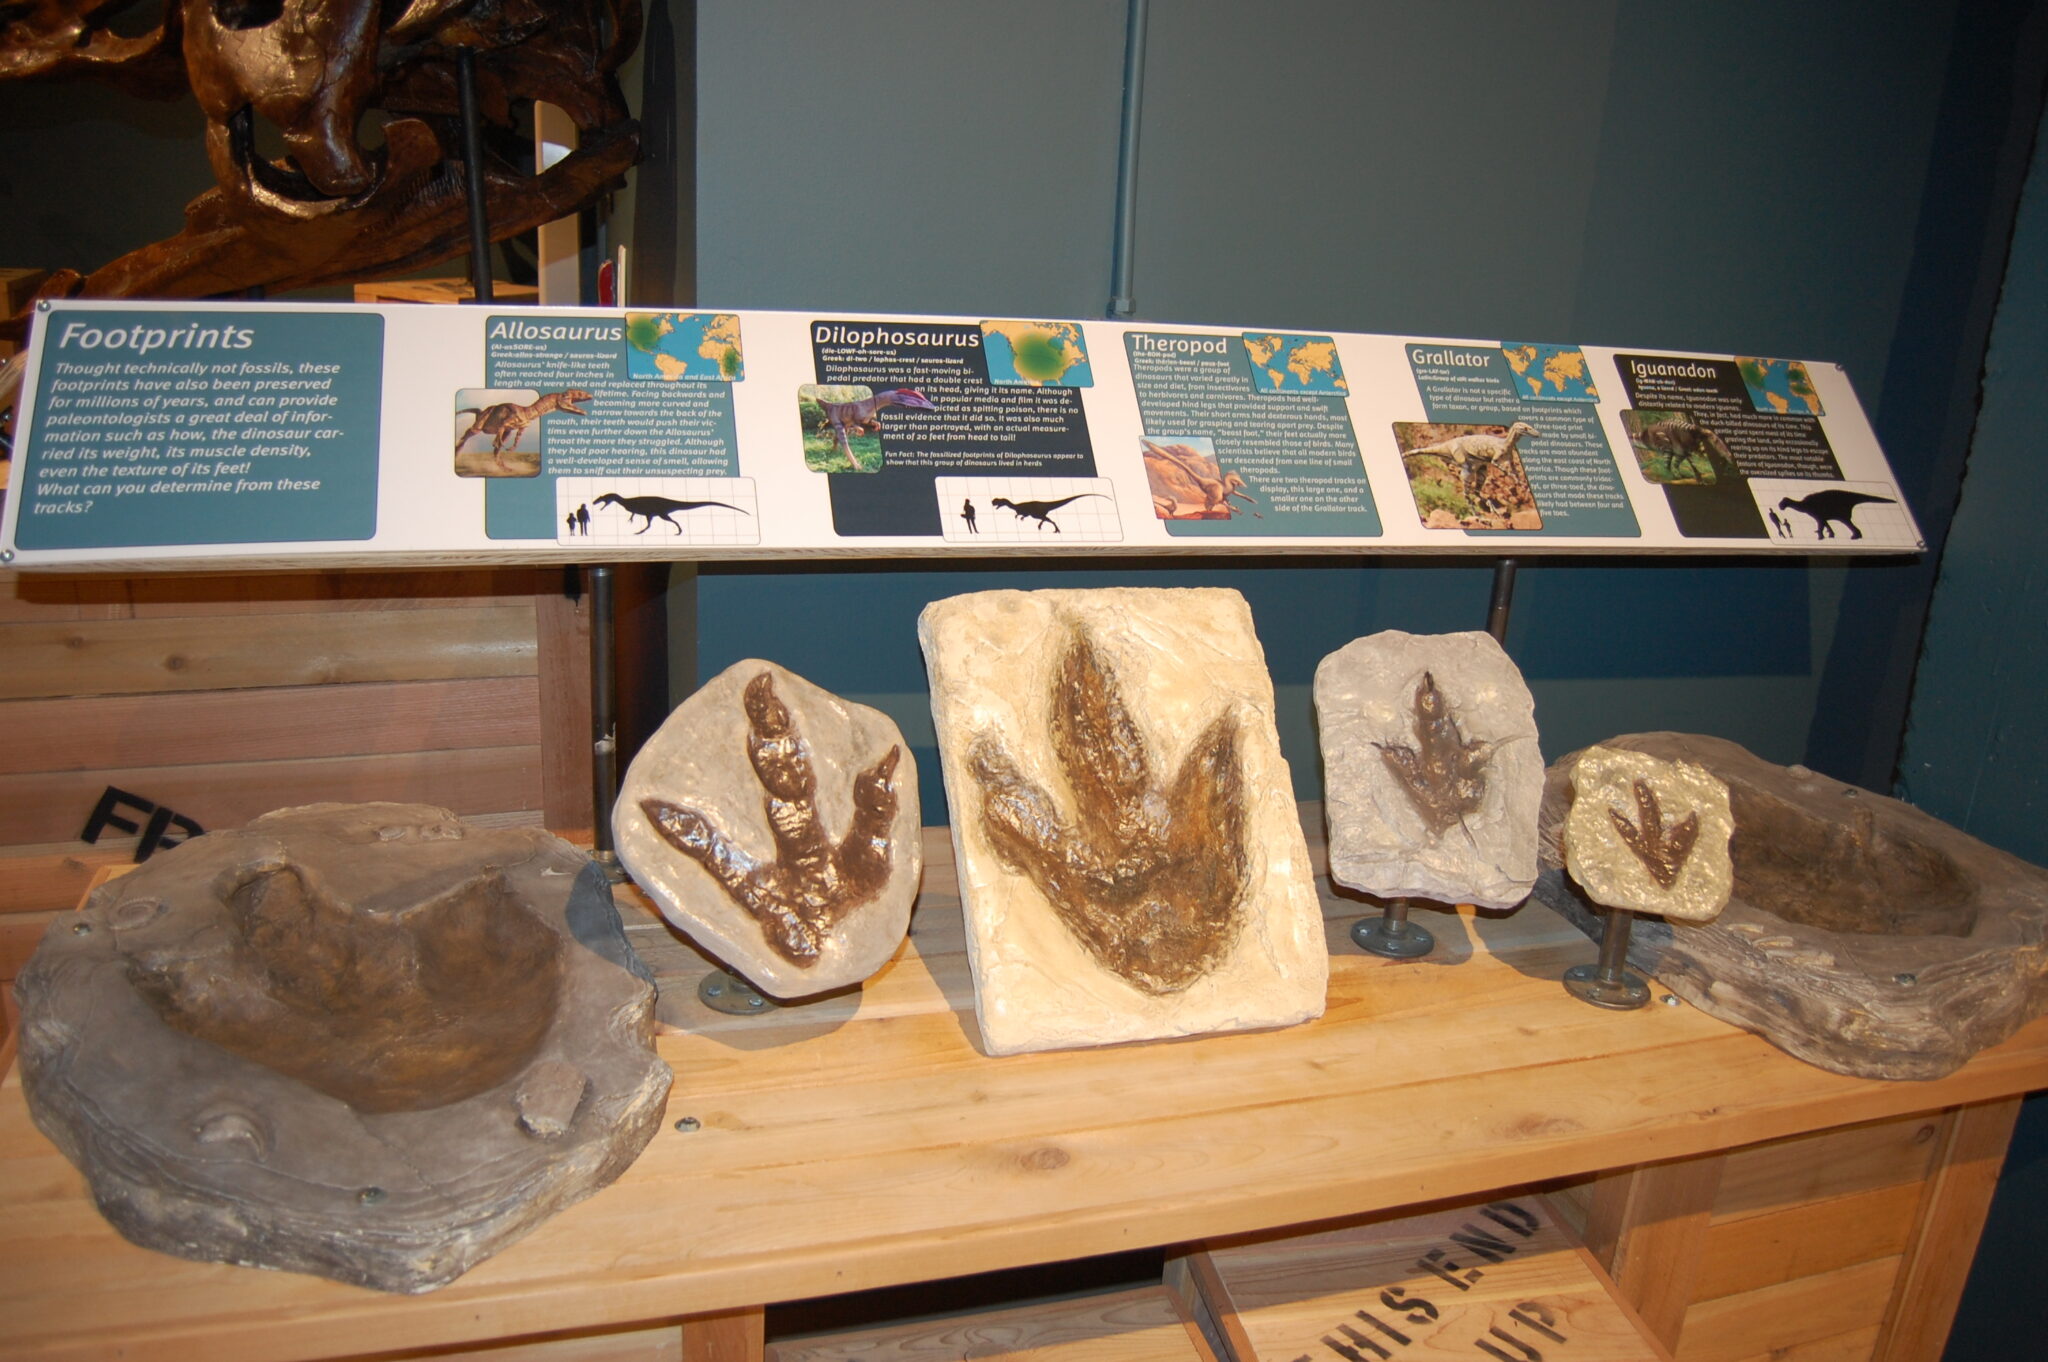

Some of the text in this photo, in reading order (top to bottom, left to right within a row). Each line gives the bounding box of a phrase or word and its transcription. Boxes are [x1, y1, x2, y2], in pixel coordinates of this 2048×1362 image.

[59, 322, 255, 355] Footprints
[490, 321, 622, 341] Allosaurus
[815, 326, 979, 348] Dilophosaurus
[1131, 334, 1227, 354] Theropod
[1411, 348, 1490, 367] Grallator
[56, 361, 340, 376] Thought technically not fossils, these
[825, 364, 886, 376] Dilophosaurus
[912, 366, 961, 376] fast-moving
[1630, 359, 1716, 379] Iguanadon
[51, 377, 332, 392] footprints have also been preserved
[492, 379, 522, 390] length
[607, 380, 645, 389] replaced
[646, 381, 695, 390] throughout
[696, 381, 707, 389] its
[826, 374, 850, 383] pedal
[851, 374, 888, 383] predator
[889, 374, 906, 382] that
[907, 375, 924, 383] had
[932, 375, 961, 383] double
[48, 393, 338, 409] for millions of years, and can provide
[45, 409, 332, 426] paleontologists a great deal of infor-
[44, 427, 344, 442] mation such as how, the dinosaur car-
[881, 422, 907, 431] larger
[908, 422, 928, 430] than
[973, 423, 991, 431] with
[617, 437, 637, 447] they
[684, 437, 724, 447] Although
[882, 432, 904, 440] ment
[905, 431, 915, 441] of
[928, 432, 945, 441] feet
[946, 432, 966, 441] from
[967, 432, 988, 440] head
[989, 433, 998, 441] to
[41, 443, 311, 461] ried its weight, its muscle density,
[547, 447, 567, 456] they
[568, 446, 587, 454] had
[587, 448, 609, 456] poor
[649, 447, 667, 455] this
[668, 447, 707, 455] dinosaur
[708, 447, 726, 455] had
[38, 461, 251, 477] even the texture of its feet!
[581, 466, 604, 478] sniff
[642, 467, 704, 478] unsuspecting
[37, 477, 320, 496] What can you determine from these
[33, 500, 93, 514] tracks?
[1291, 1201, 1541, 1362] HIS END
[1474, 1301, 1567, 1362] UP
